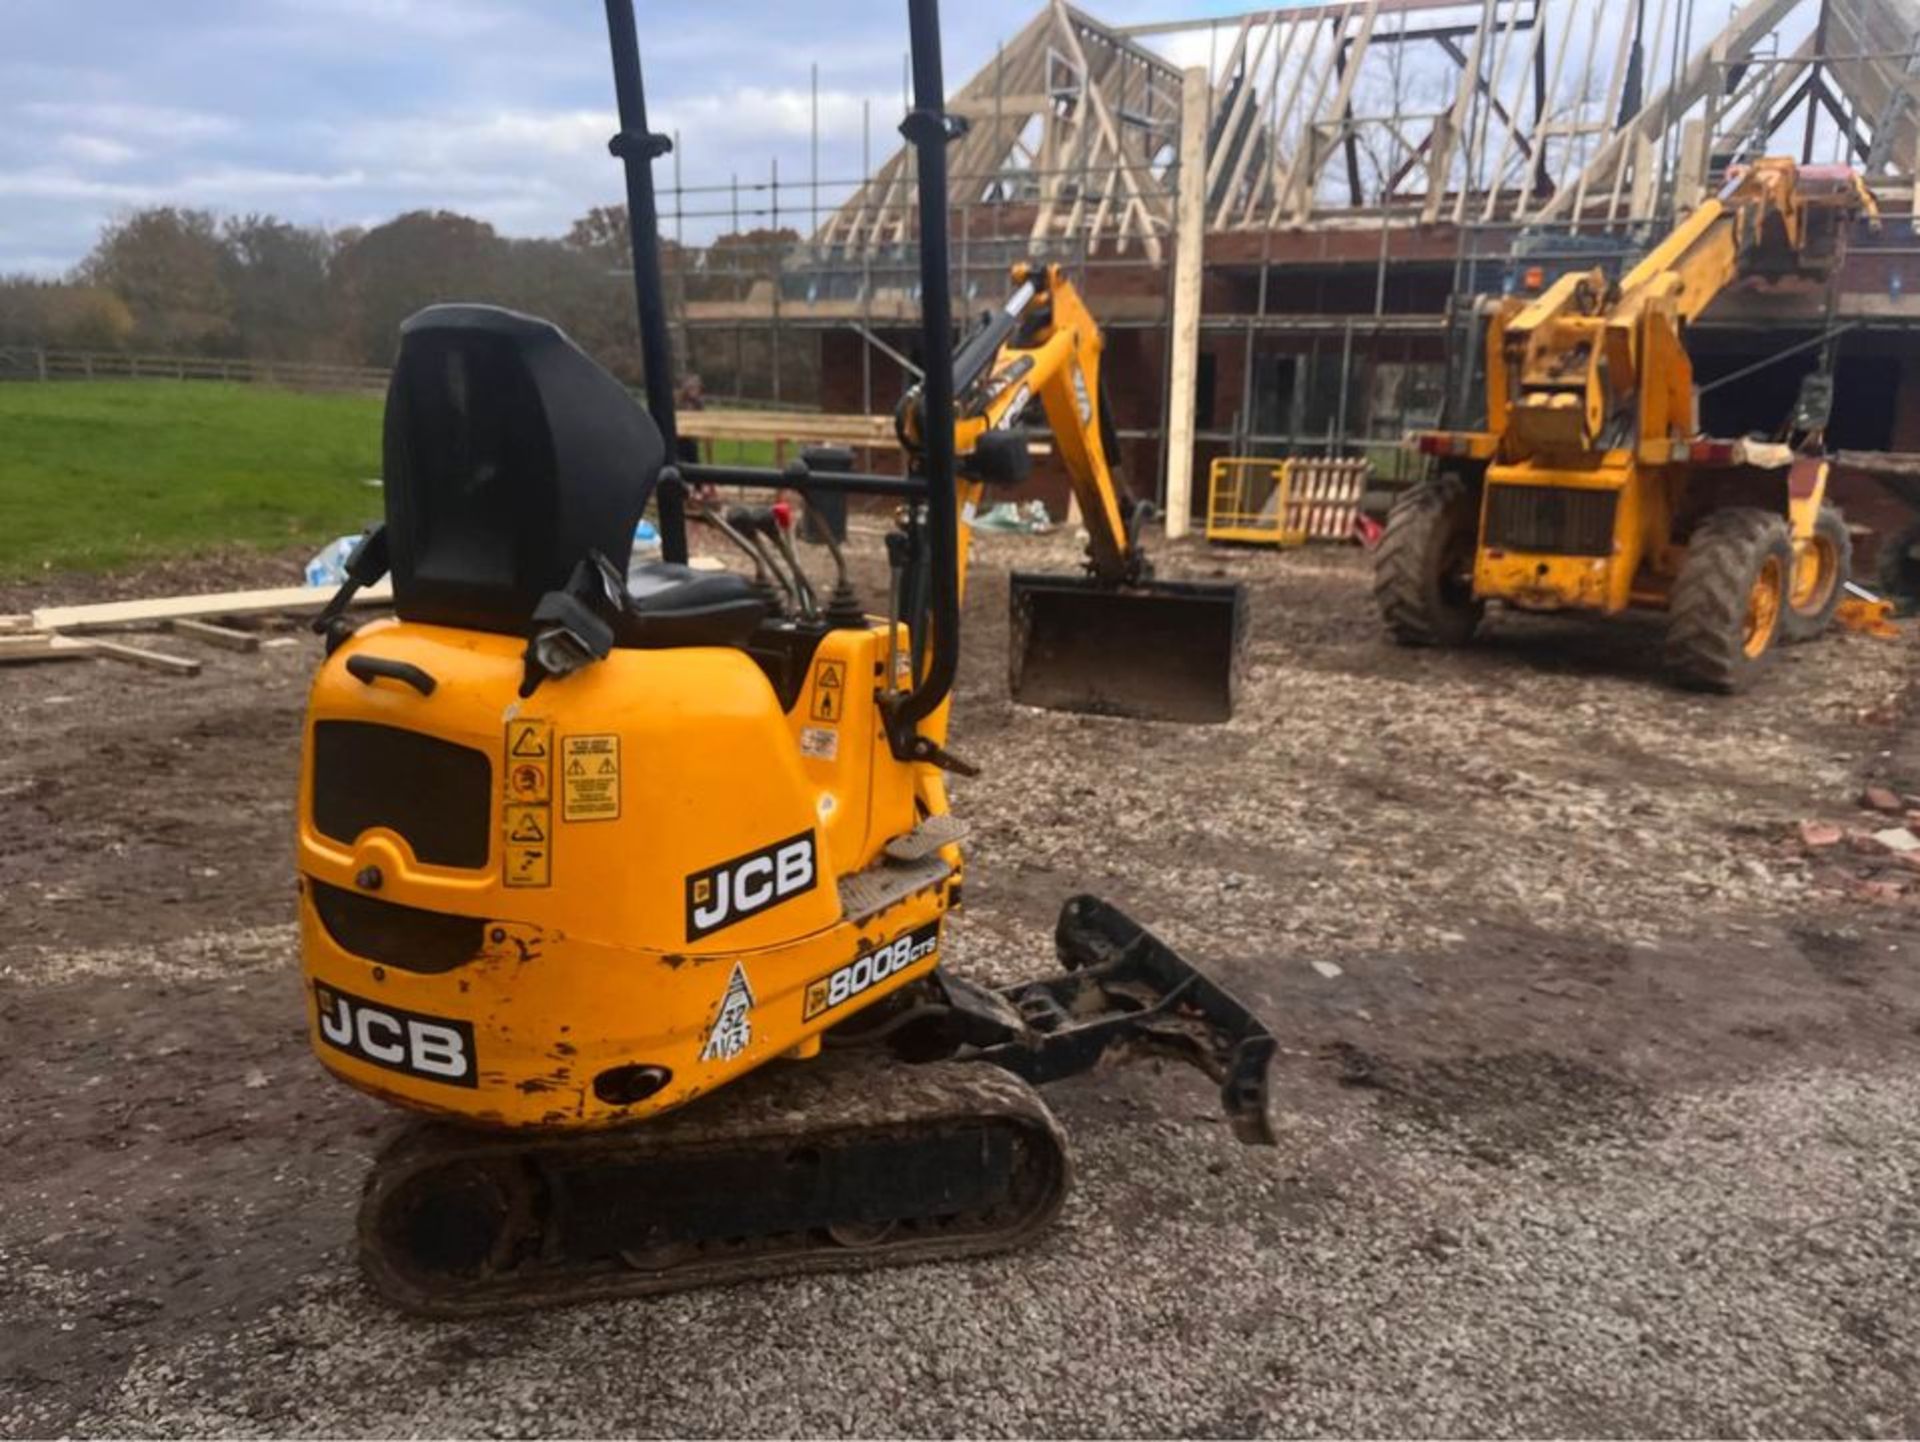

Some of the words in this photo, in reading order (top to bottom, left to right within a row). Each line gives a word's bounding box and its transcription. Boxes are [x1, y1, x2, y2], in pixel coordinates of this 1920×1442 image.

[694, 840, 812, 929] JCB
[322, 998, 467, 1077] JCB
[722, 1004, 746, 1034] 32
